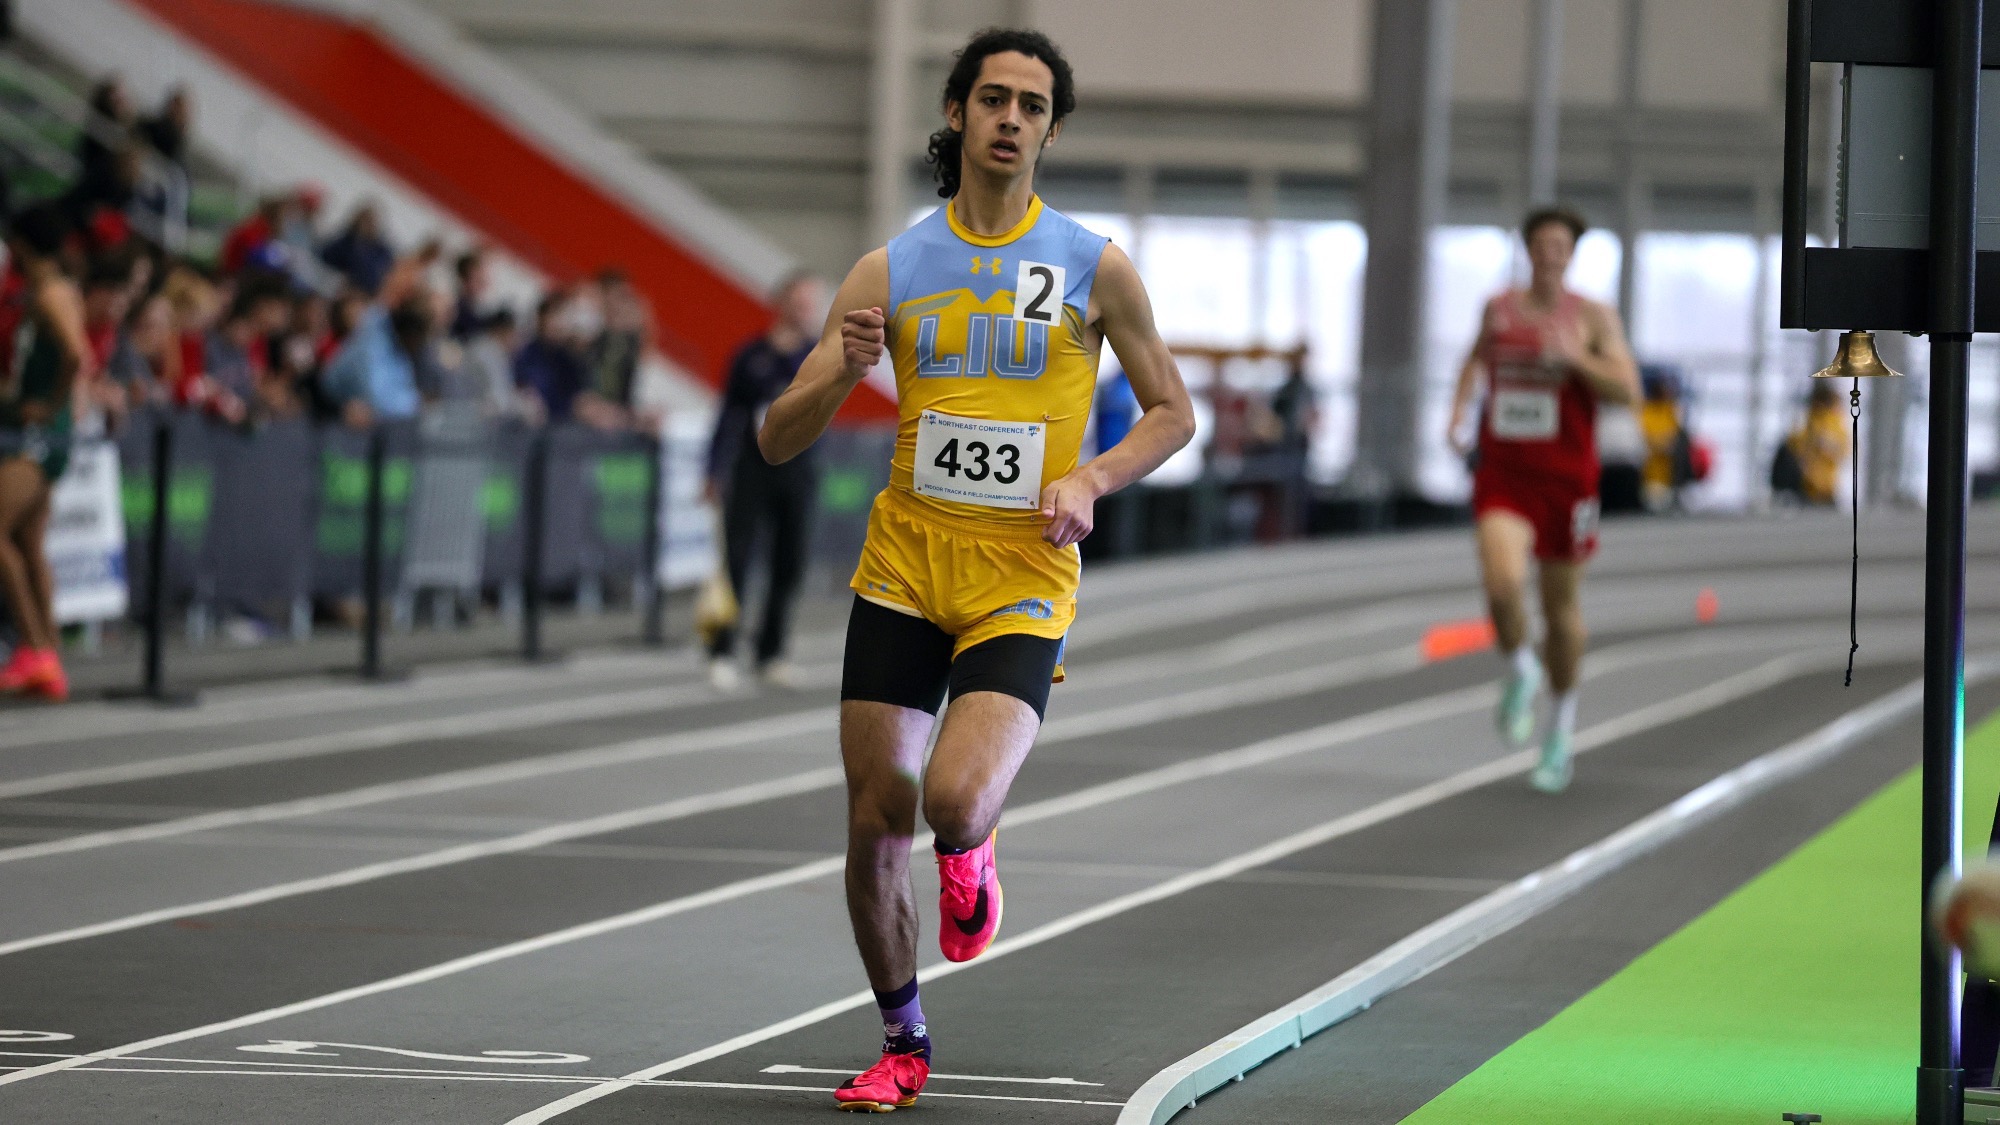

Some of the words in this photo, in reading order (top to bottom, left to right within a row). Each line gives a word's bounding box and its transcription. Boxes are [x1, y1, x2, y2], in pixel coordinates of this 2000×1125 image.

[1023, 266, 1055, 322] 2
[917, 312, 1048, 380] LIU
[938, 419, 977, 431] NORTHEAST
[978, 425, 1025, 435] CONFERENCE
[934, 438, 1021, 484] 433
[924, 483, 944, 492] INDOOR
[944, 487, 962, 495] TRACK
[984, 493, 1028, 502] CHAMPIONSHIPS
